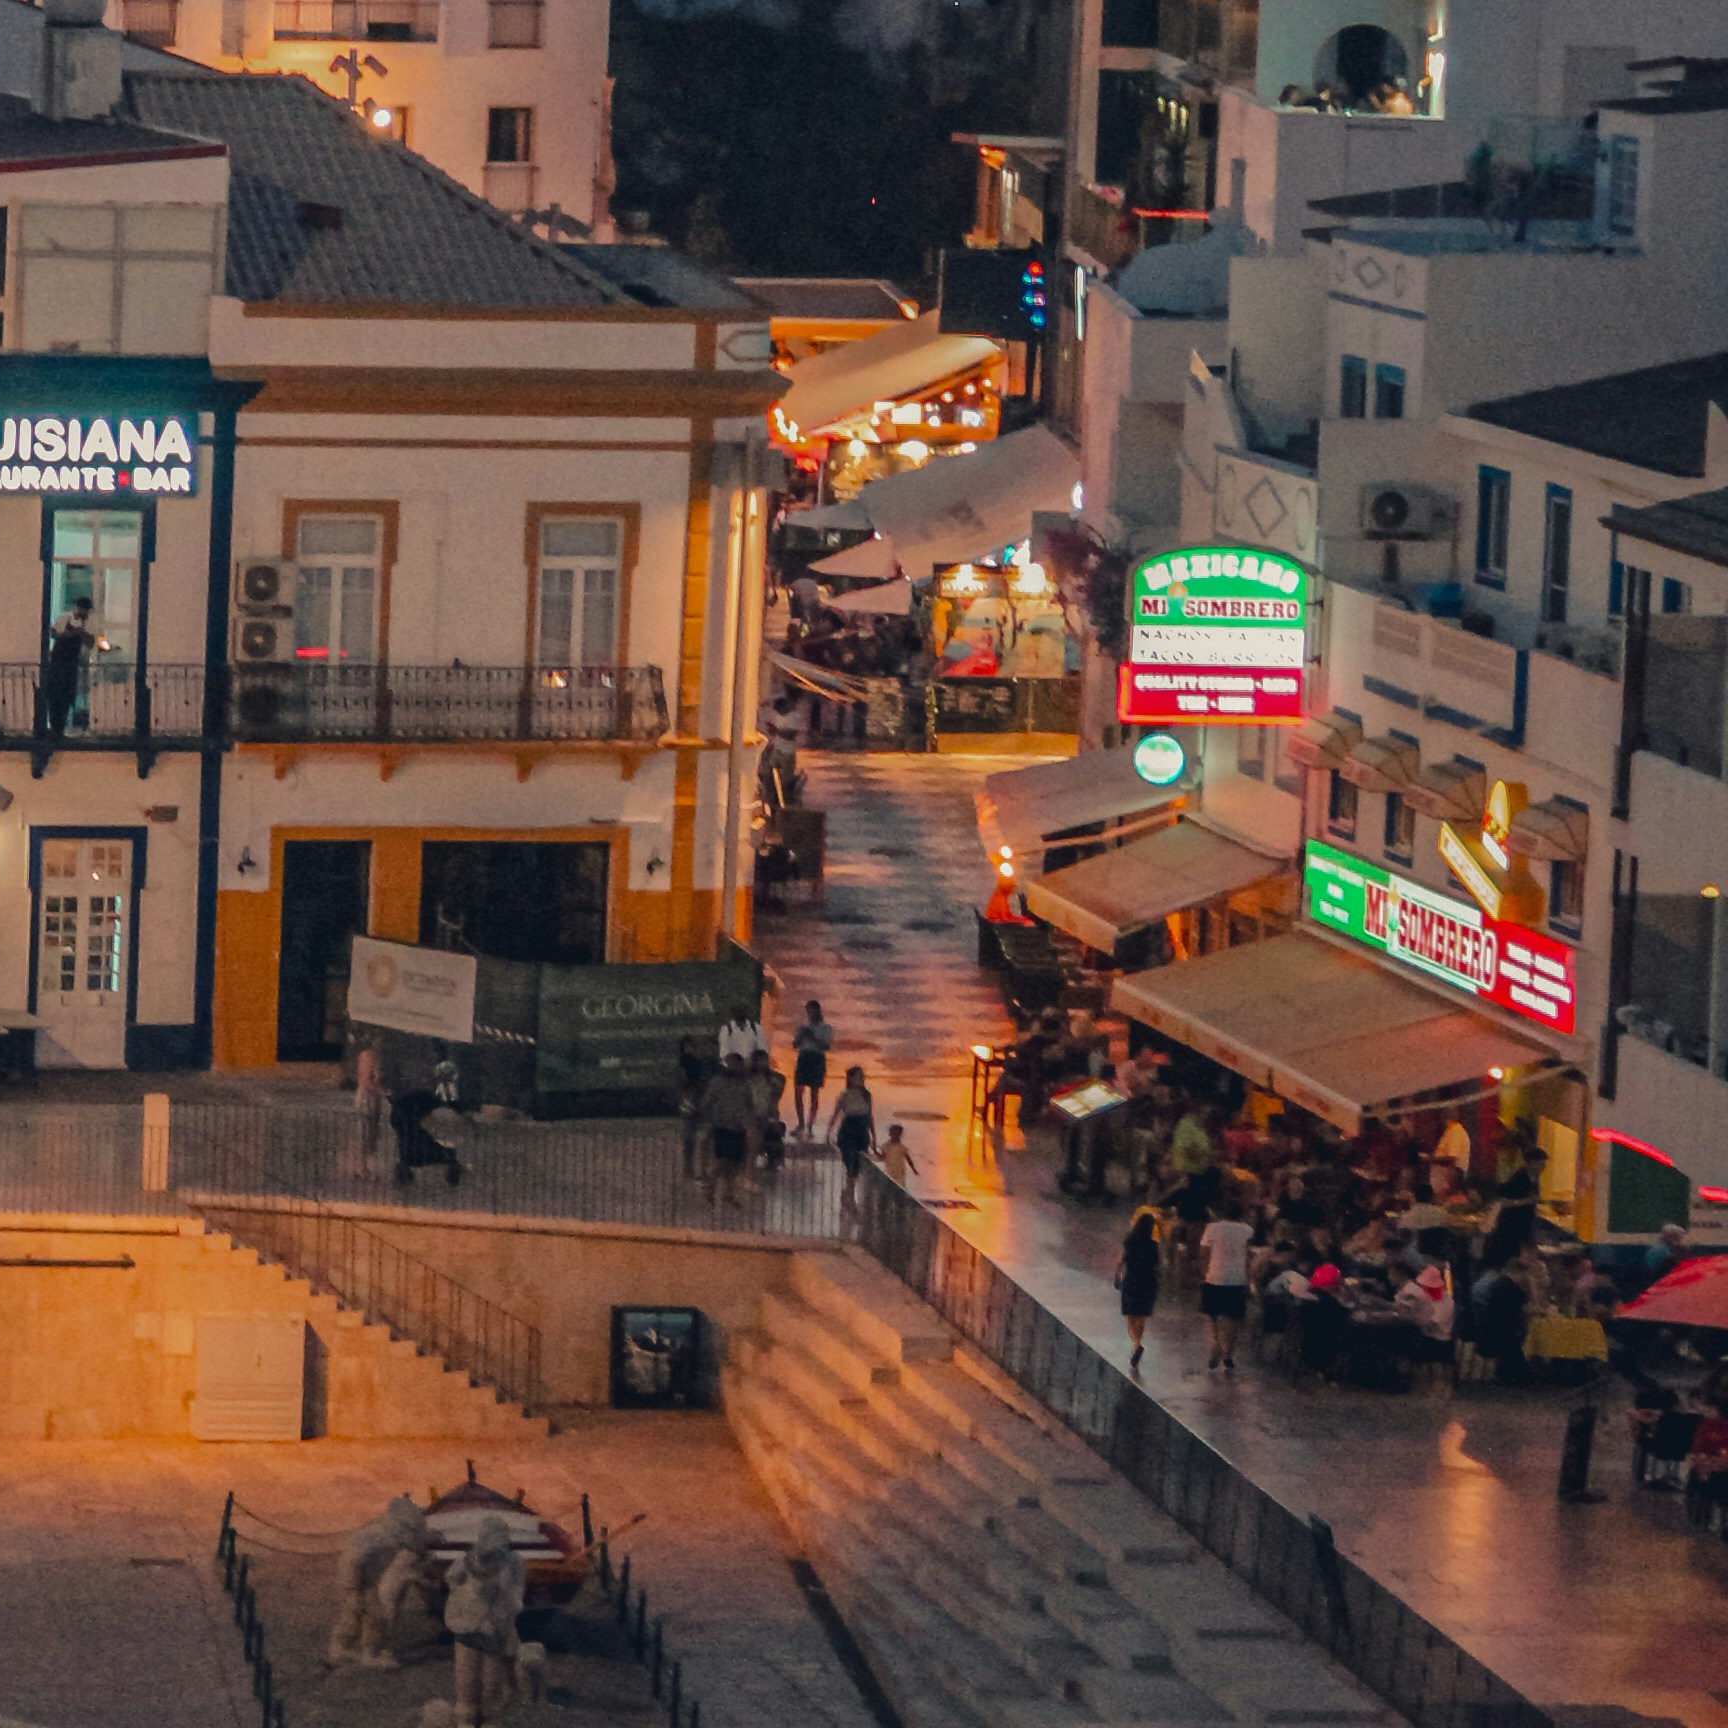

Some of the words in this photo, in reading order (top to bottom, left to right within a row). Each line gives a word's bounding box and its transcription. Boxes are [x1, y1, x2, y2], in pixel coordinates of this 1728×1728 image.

[133, 466, 191, 492] BAR
[1143, 553, 1300, 594] MEXICANO
[1140, 598, 1167, 615] MI
[1184, 599, 1299, 619] SOMBRERO
[1366, 882, 1388, 940] MI
[1398, 897, 1495, 989] SOMBRERO
[582, 993, 714, 1018] GEORGINA
